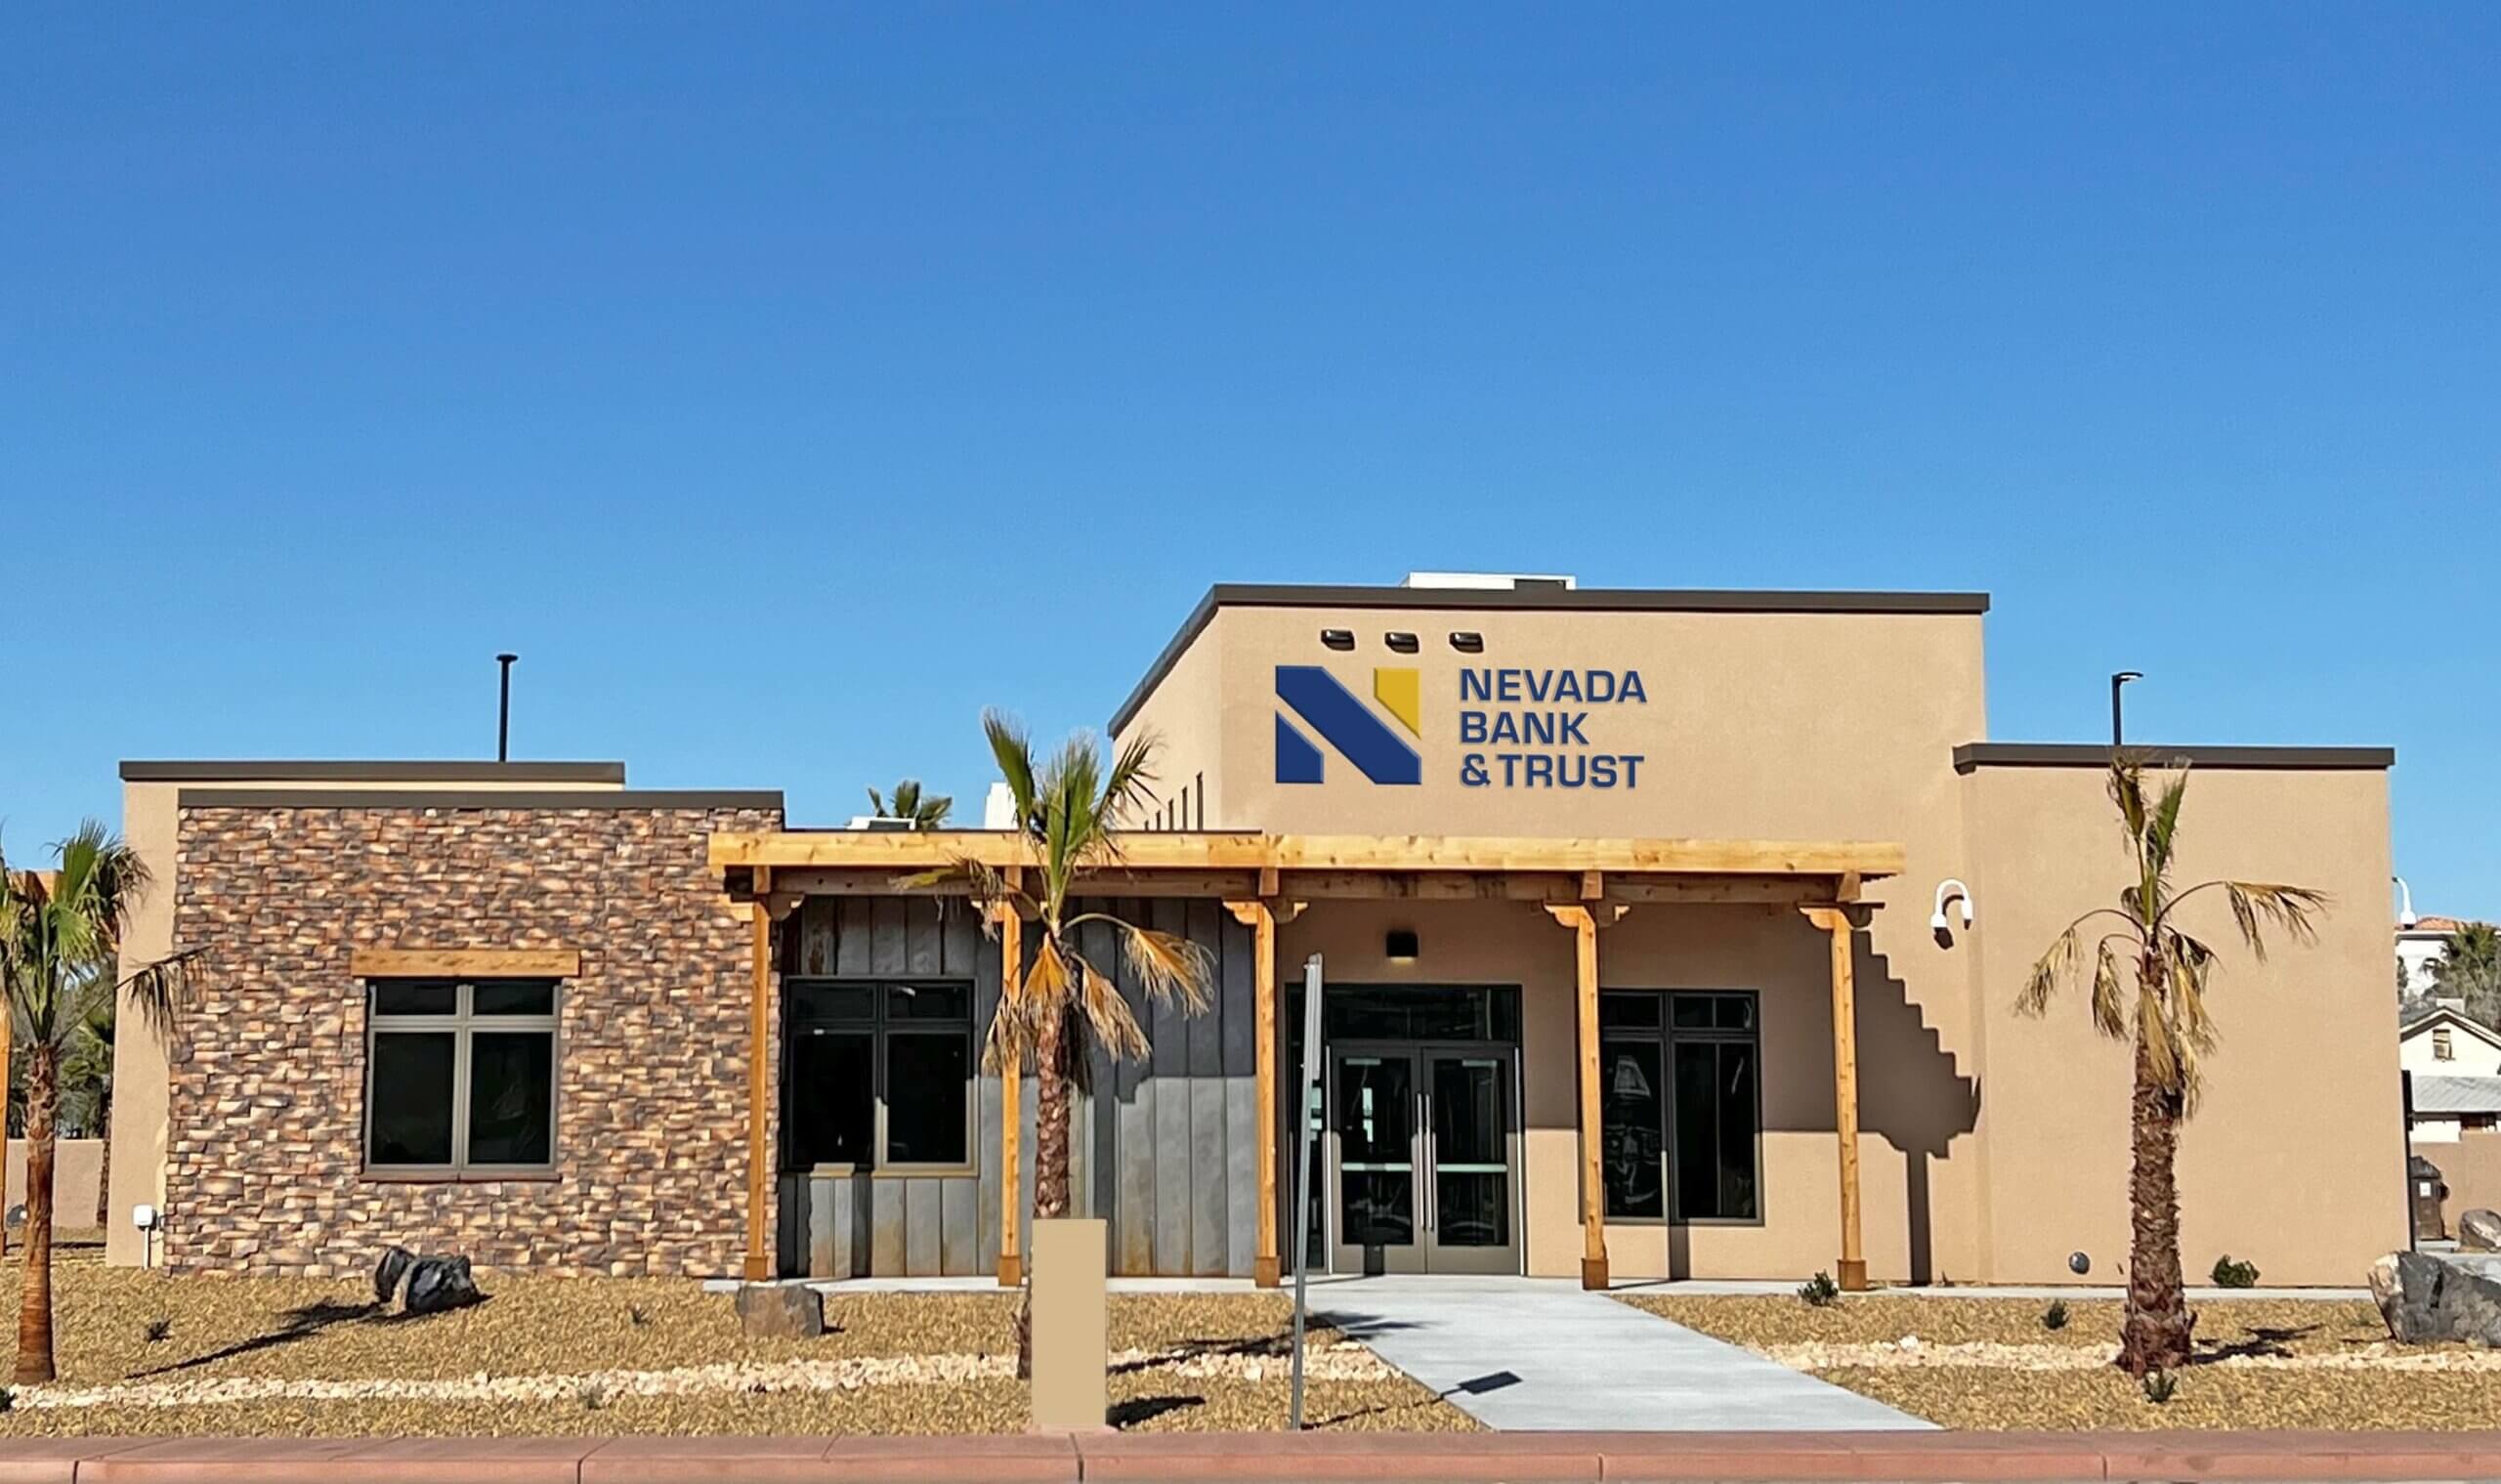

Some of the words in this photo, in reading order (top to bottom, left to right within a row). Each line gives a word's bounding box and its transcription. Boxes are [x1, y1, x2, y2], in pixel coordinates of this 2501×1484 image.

[1460, 668, 1647, 703] NEVADA
[1460, 710, 1589, 744] BANK
[1461, 753, 1492, 786] &
[1497, 755, 1644, 787] TRUST
